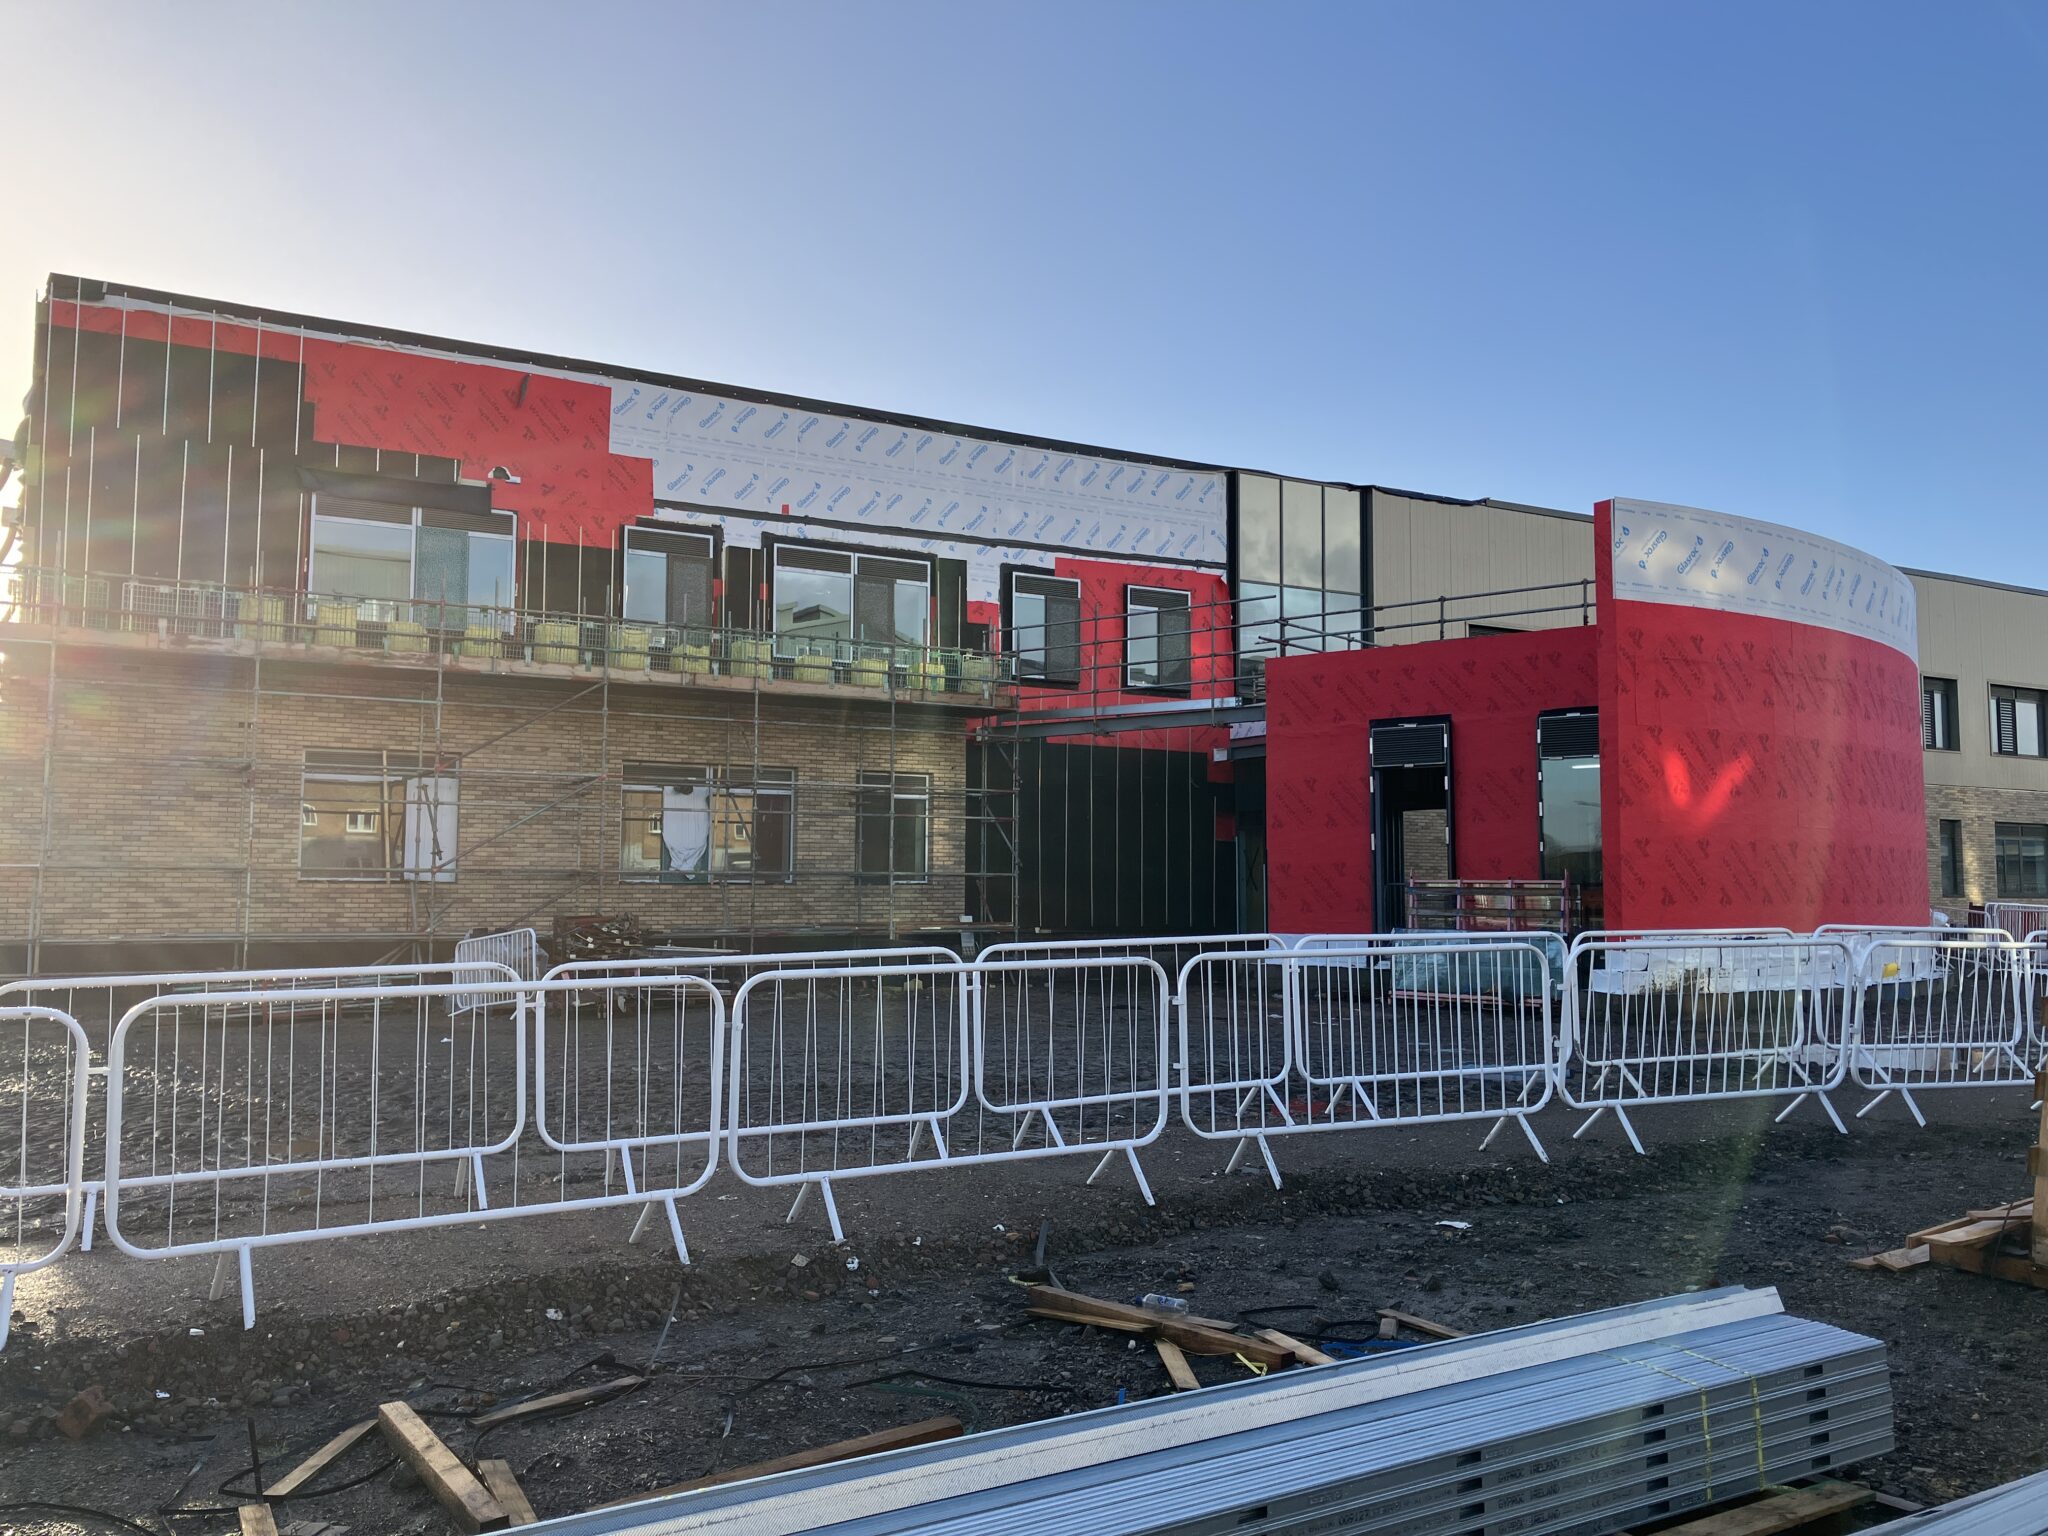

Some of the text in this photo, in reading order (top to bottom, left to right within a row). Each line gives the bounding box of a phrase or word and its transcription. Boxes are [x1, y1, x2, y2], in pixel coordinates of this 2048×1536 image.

[613, 395, 634, 415] Glasroc
[671, 397, 691, 415] Glasroc
[699, 408, 720, 428] Glasroc
[737, 407, 757, 428] Glasroc
[800, 417, 819, 434] Glasroc
[764, 420, 784, 438] Glasroc
[860, 427, 879, 445] Glasroc
[825, 430, 845, 448] Glasroc
[667, 471, 689, 491] Glasroc
[705, 469, 726, 488] Glasroc
[769, 479, 789, 496] Glasroc
[734, 481, 754, 499] Glasroc
[797, 490, 816, 508] Glasroc
[832, 487, 851, 505] Glasroc
[858, 499, 876, 516] Glasroc
[1645, 530, 1667, 558] Glasroc
[1677, 547, 1699, 574] Glasroc
[1715, 541, 1734, 567] Glasroc
[1747, 559, 1765, 585] Glasroc
